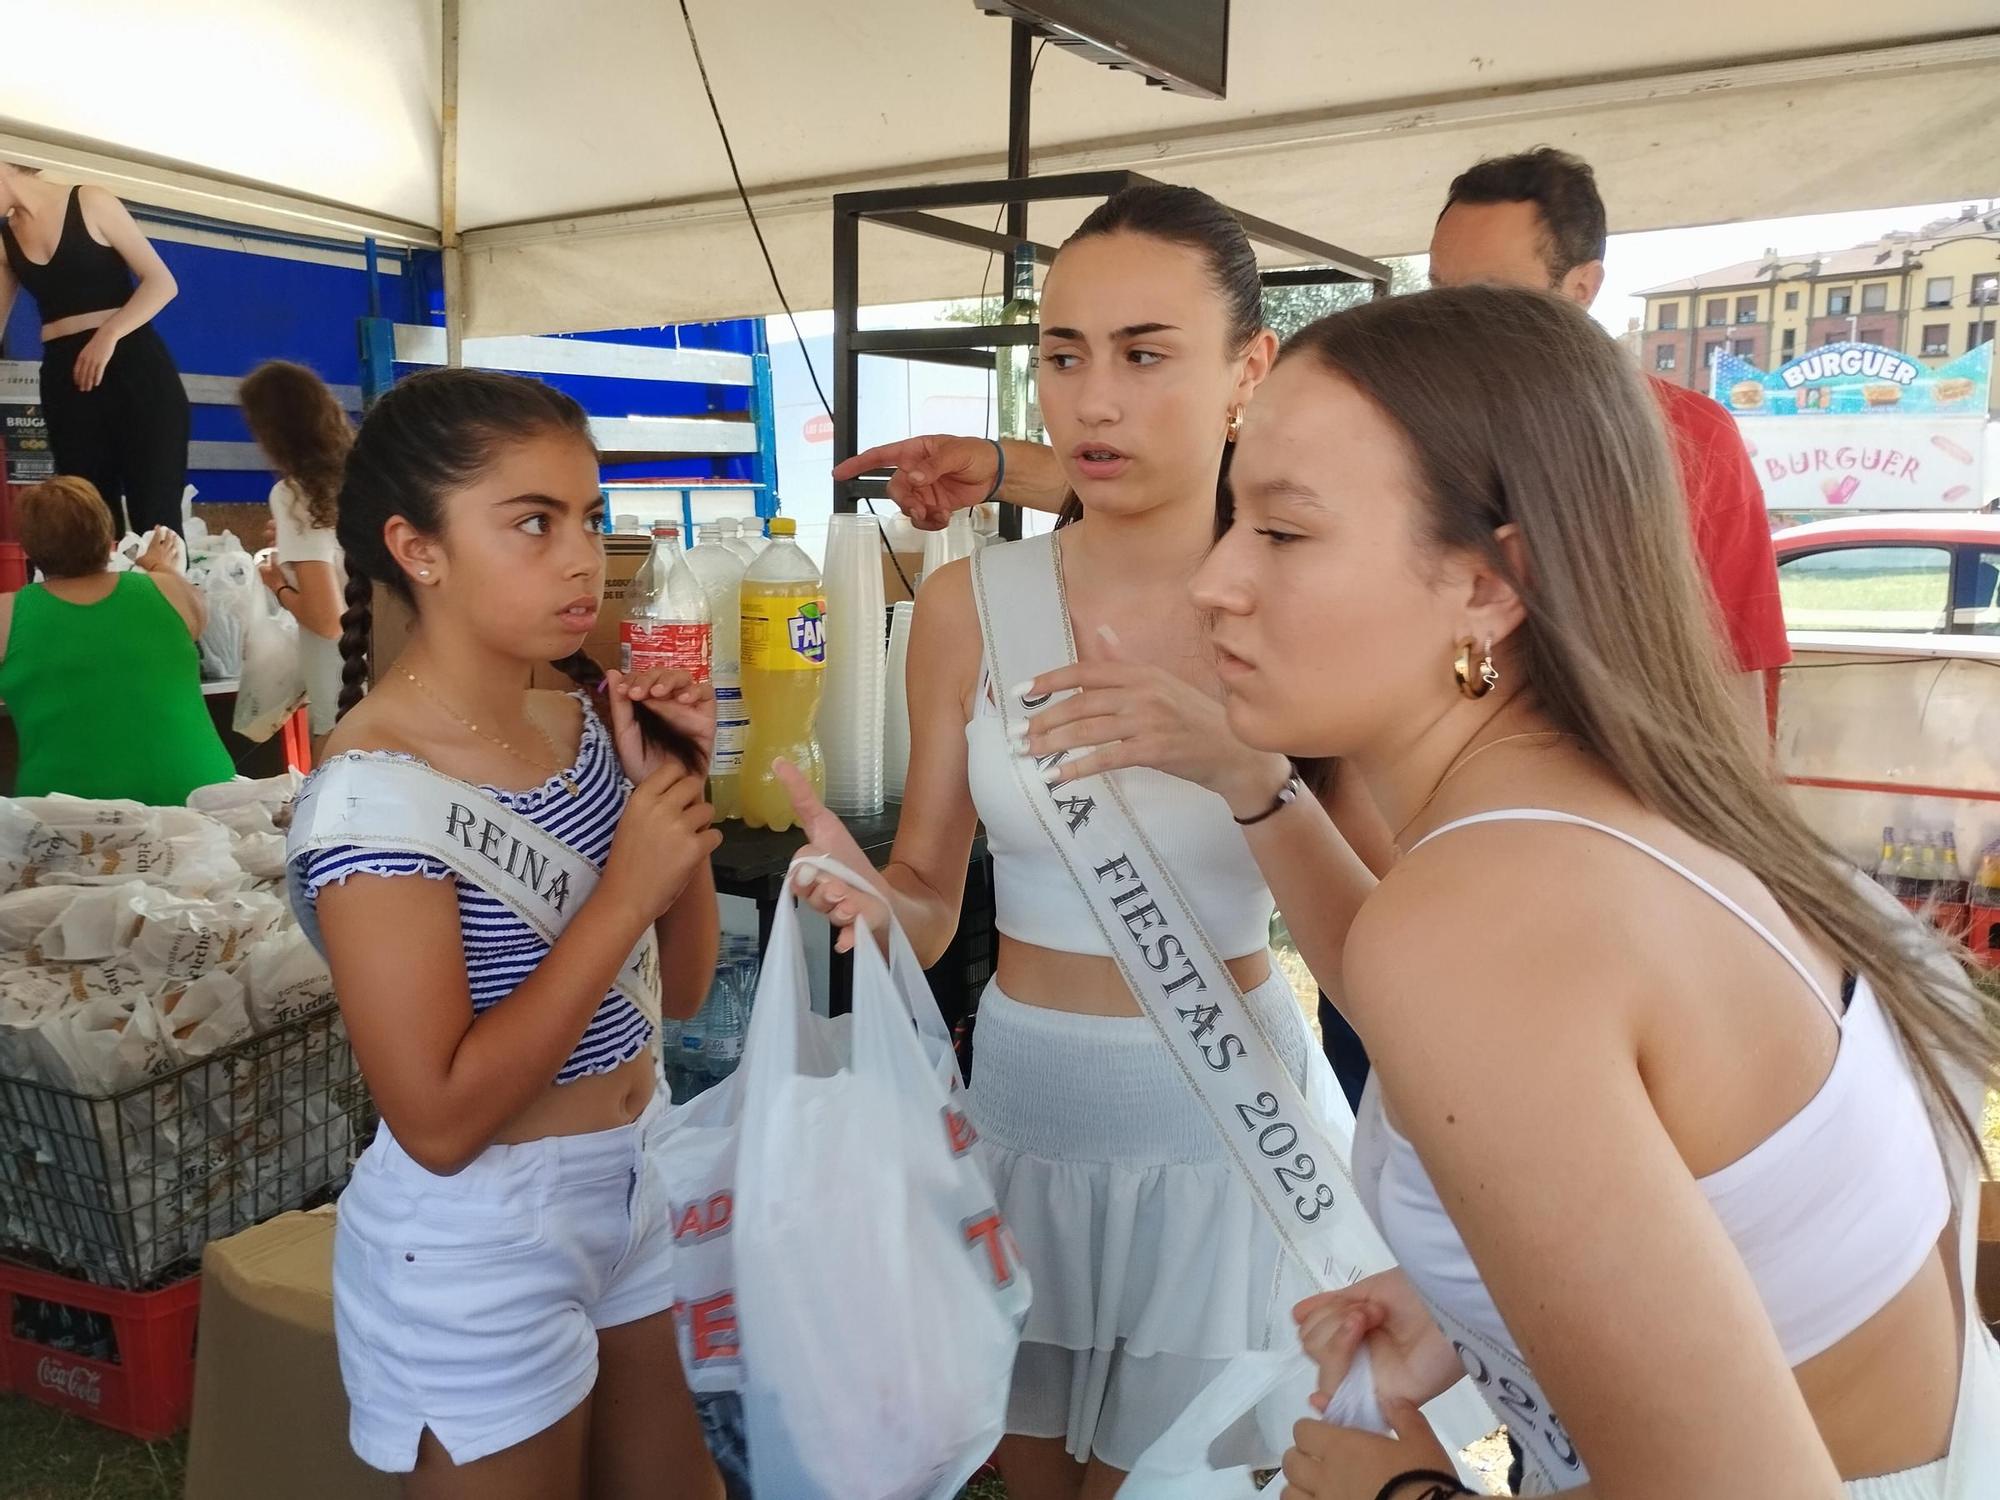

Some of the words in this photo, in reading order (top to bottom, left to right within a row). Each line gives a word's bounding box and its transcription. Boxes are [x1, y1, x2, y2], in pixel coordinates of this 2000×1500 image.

[1781, 349, 1918, 389] BURGUER
[1766, 446, 1920, 484] BURGUER
[445, 802, 571, 916] REINA
[1092, 852, 1248, 1073] FIESTAS
[1235, 1091, 1335, 1224] 2023
